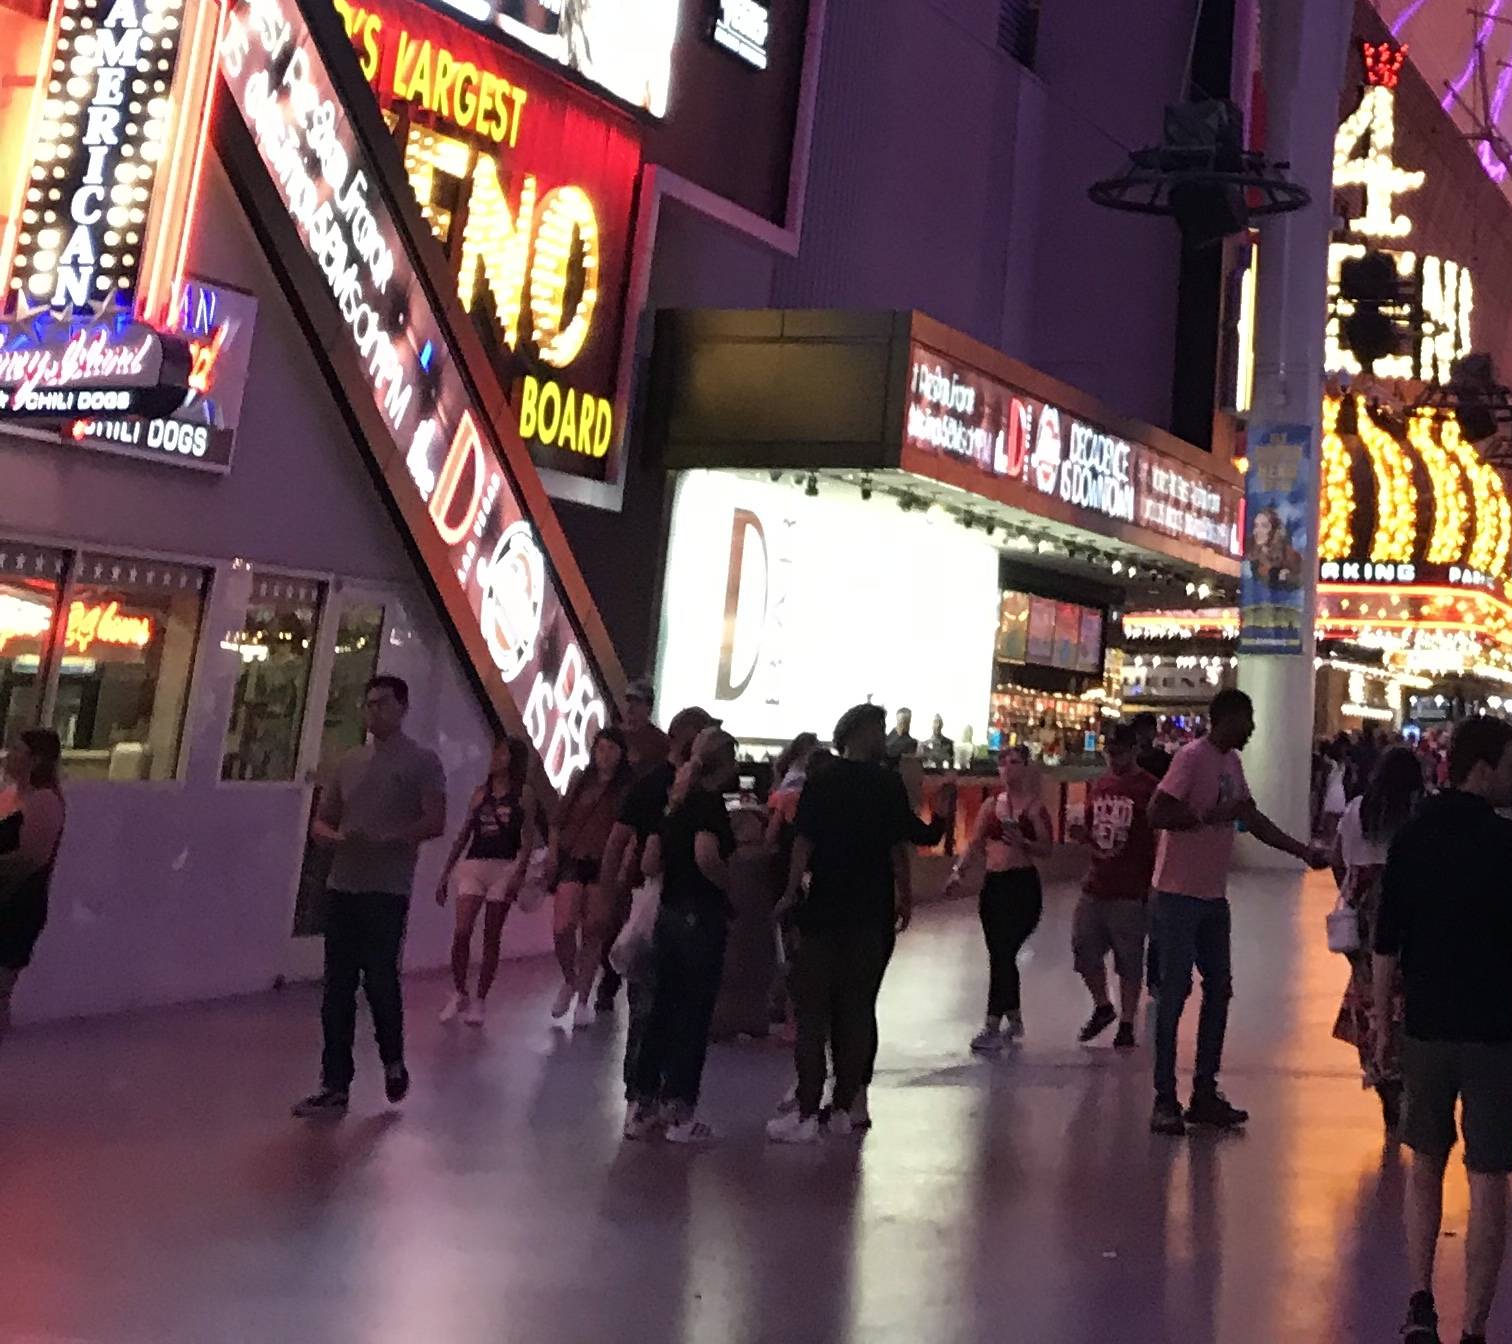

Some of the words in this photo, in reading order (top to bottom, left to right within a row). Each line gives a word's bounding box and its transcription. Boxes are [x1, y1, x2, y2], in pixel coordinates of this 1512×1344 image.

[393, 30, 528, 149] LARGEST
[147, 418, 208, 457] DOGS
[519, 375, 613, 458] BOARD
[1320, 562, 1416, 582] RKING
